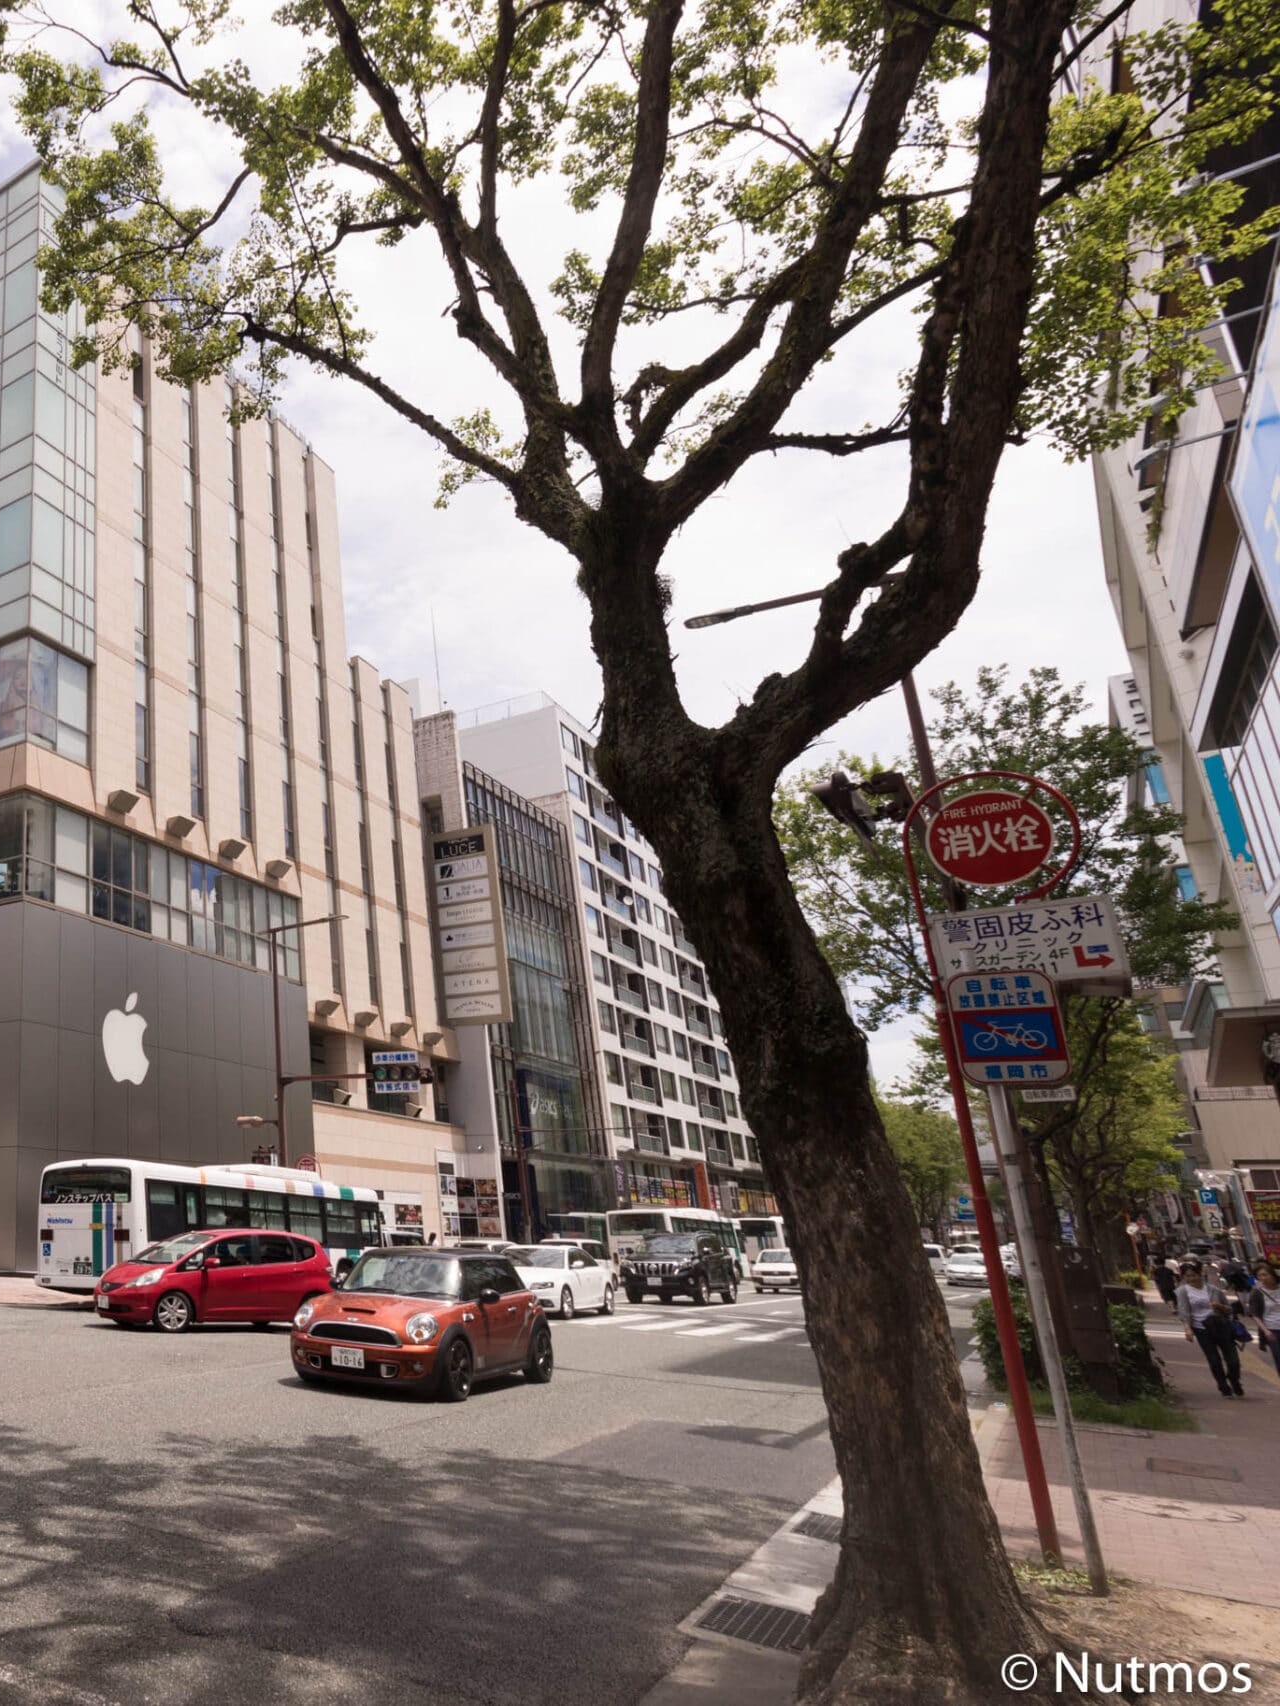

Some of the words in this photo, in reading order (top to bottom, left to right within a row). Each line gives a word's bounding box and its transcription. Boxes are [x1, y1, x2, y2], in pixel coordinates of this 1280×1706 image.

[943, 808, 967, 820] FIRE
[971, 799, 1022, 816] HYDRANT
[937, 814, 1044, 861] 消火栓
[441, 841, 477, 859] LUCE
[942, 903, 1104, 944] 警固皮ふ科
[973, 932, 1082, 954] クリニック
[950, 951, 1042, 969] サスガーデン
[1049, 948, 1070, 960] 4F
[966, 976, 1031, 992] 自転車
[959, 991, 1046, 1009] 放置禁止区域
[985, 1064, 1048, 1079] 福岡市
[56, 1193, 112, 1203] ノンステップバス
[1202, 1192, 1212, 1202] P
[1209, 1212, 1220, 1228] 入口
